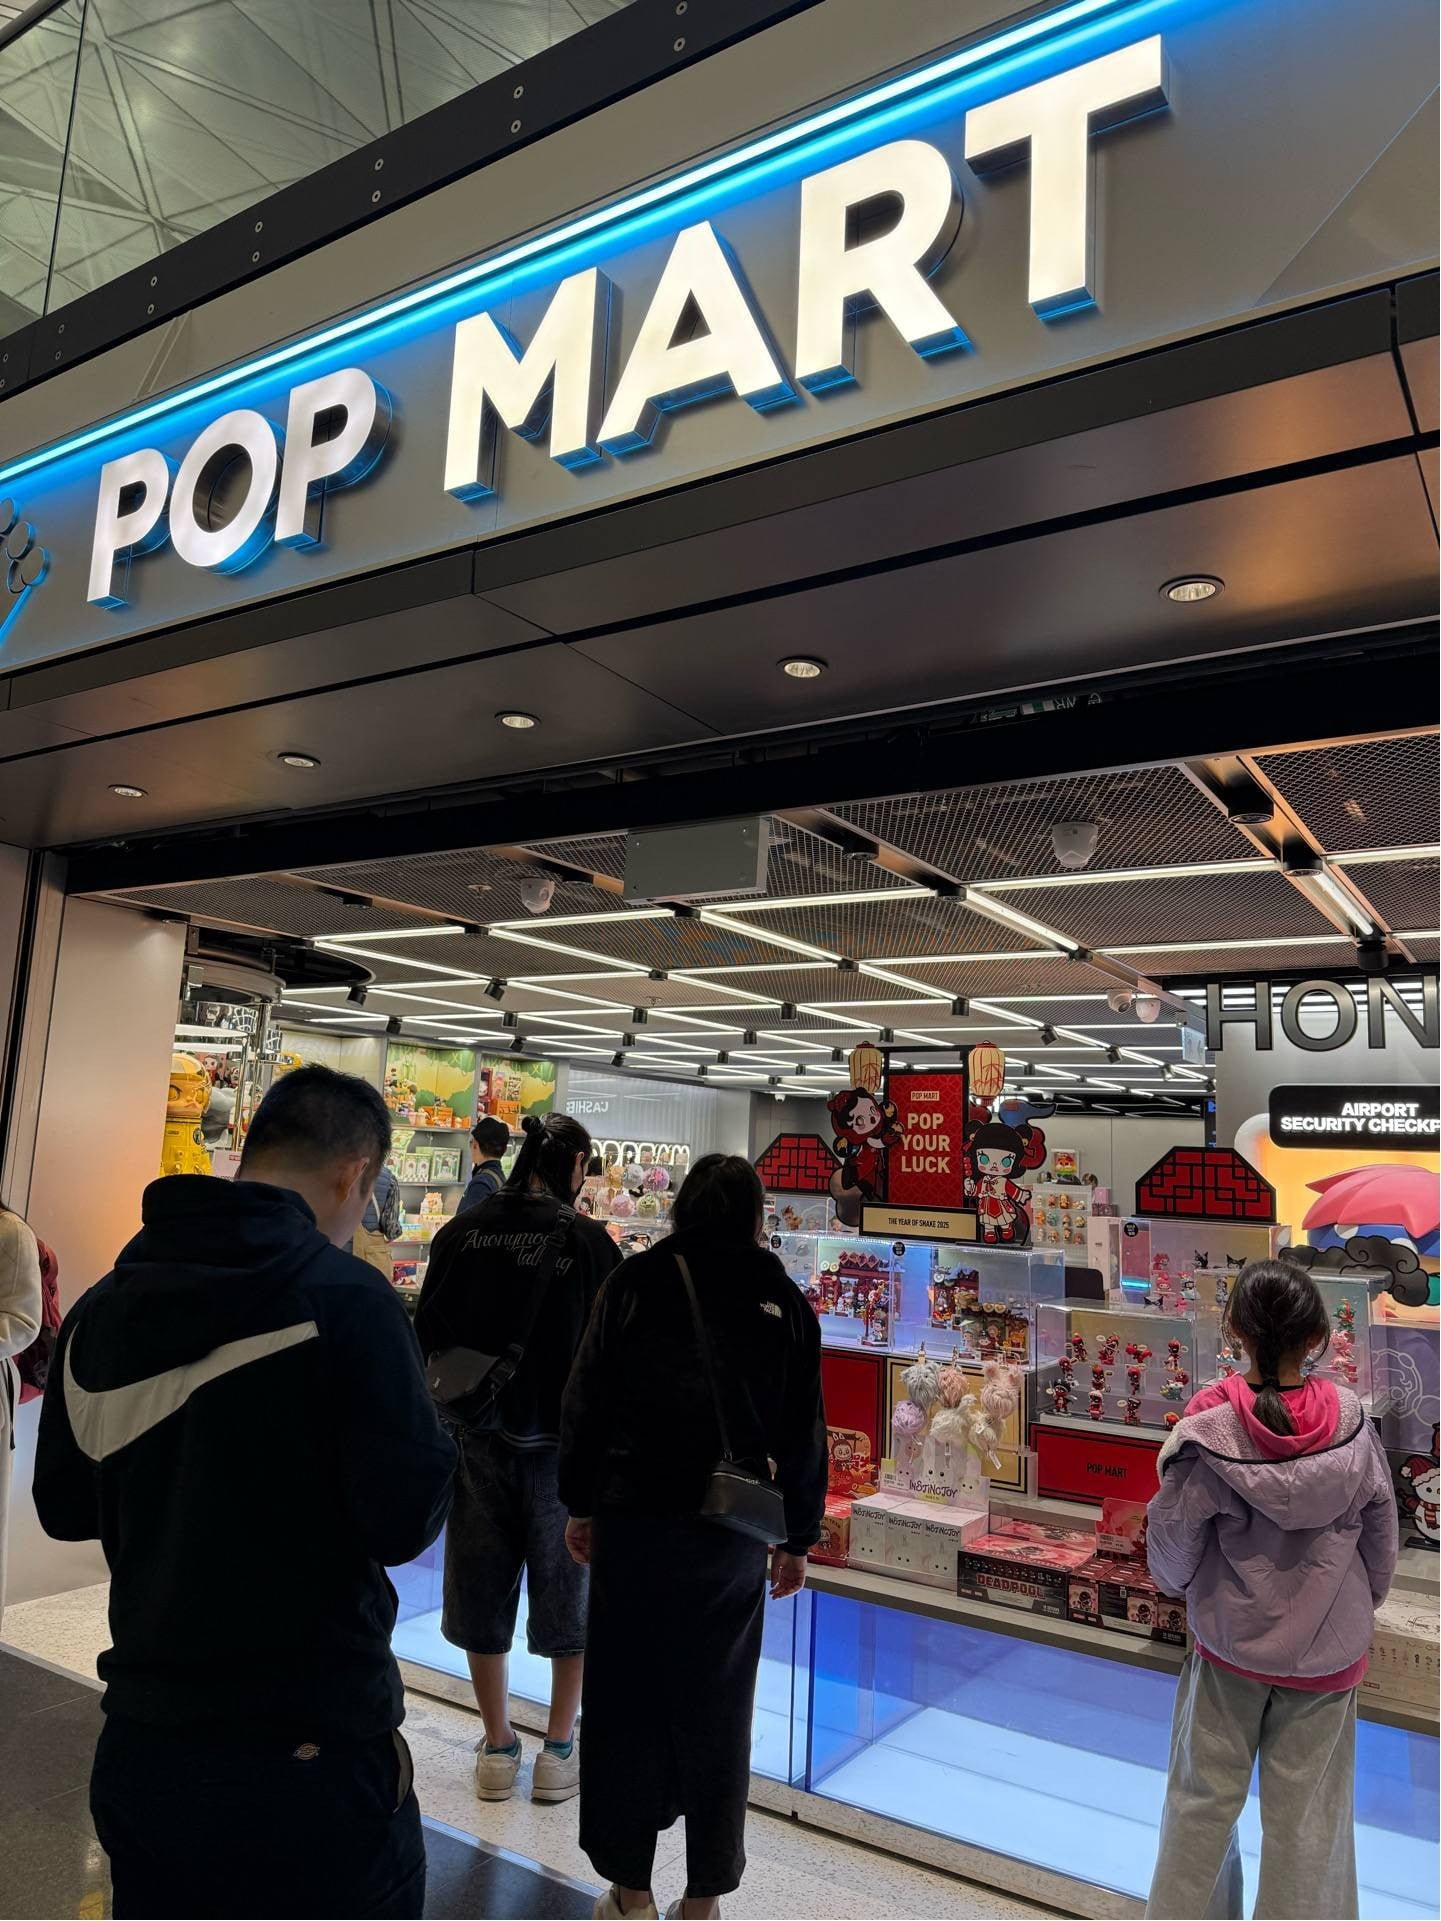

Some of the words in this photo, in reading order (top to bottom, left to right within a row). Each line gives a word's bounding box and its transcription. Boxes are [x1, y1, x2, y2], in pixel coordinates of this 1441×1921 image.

[87, 368, 389, 608] POP
[444, 34, 1168, 500] MART
[1206, 975, 1439, 1052] HON
[1341, 1103, 1419, 1117] AIRPORT
[907, 1113, 944, 1130] POP
[1281, 1116, 1366, 1132] SECURITY
[901, 1134, 951, 1151] YOUR
[901, 1156, 951, 1173] LUCK
[888, 1217, 898, 1225] THE
[898, 1218, 911, 1226] YEAR
[911, 1218, 918, 1226] OF
[919, 1219, 936, 1228] SNAKE
[937, 1220, 949, 1229] 2025
[1087, 1463, 1103, 1474] POP
[1104, 1465, 1128, 1479] MART
[976, 1573, 1046, 1600] DEADPOOL
